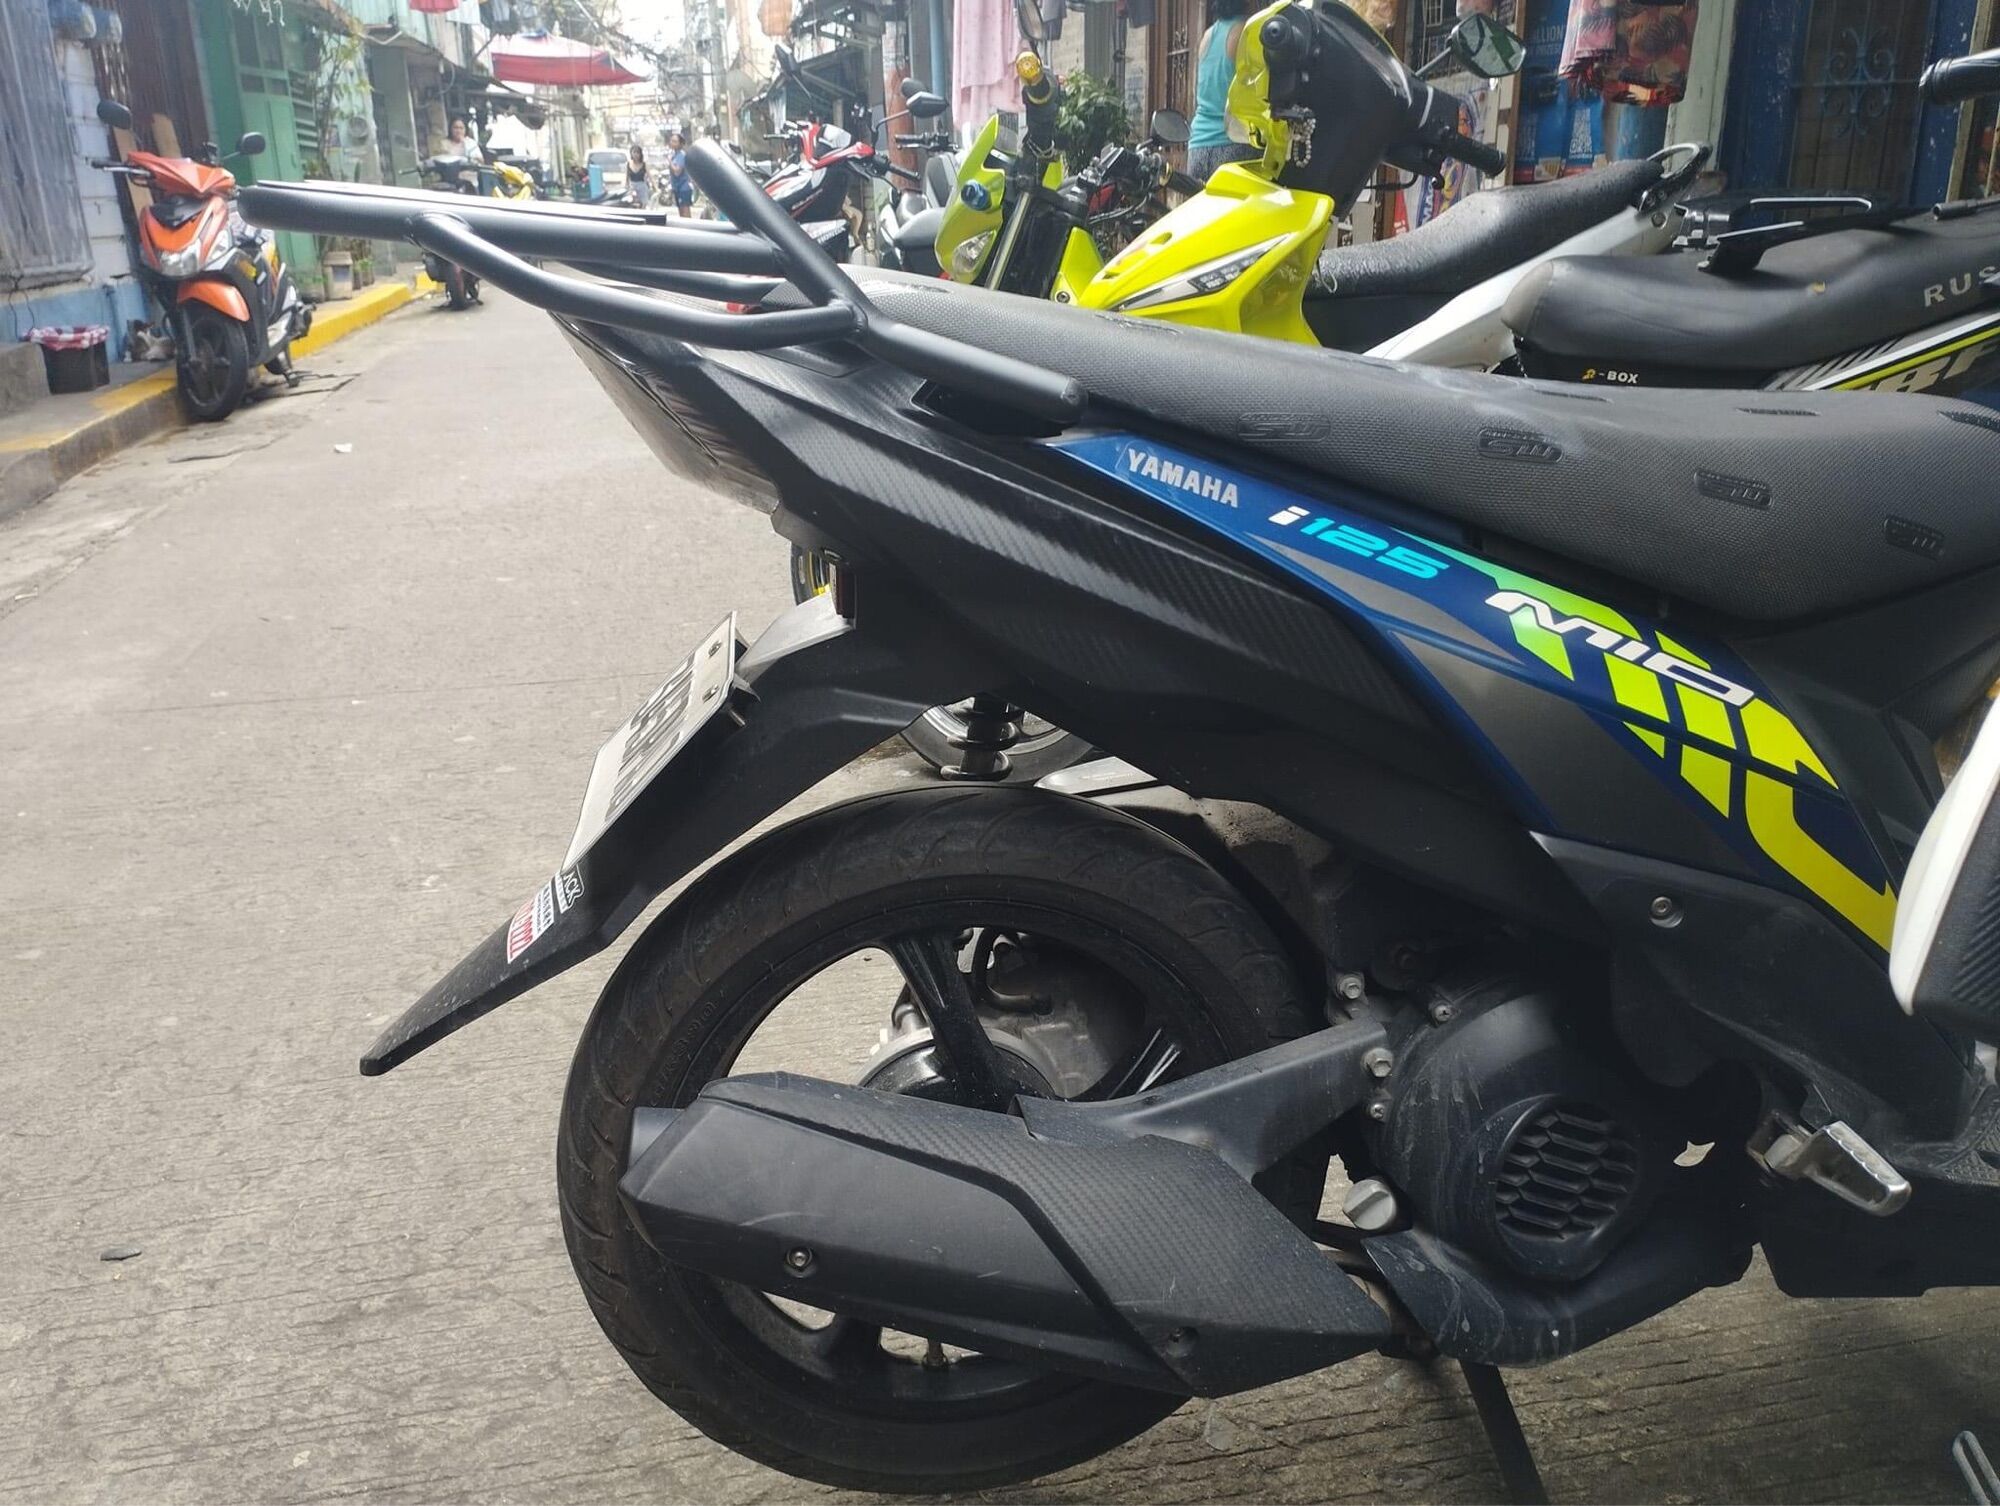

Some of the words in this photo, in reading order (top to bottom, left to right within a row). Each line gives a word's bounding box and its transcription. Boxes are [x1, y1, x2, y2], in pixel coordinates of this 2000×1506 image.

[1128, 448, 1239, 508] YAMAHA
[1268, 505, 1450, 580] i125
[1485, 590, 1755, 707] MIO
